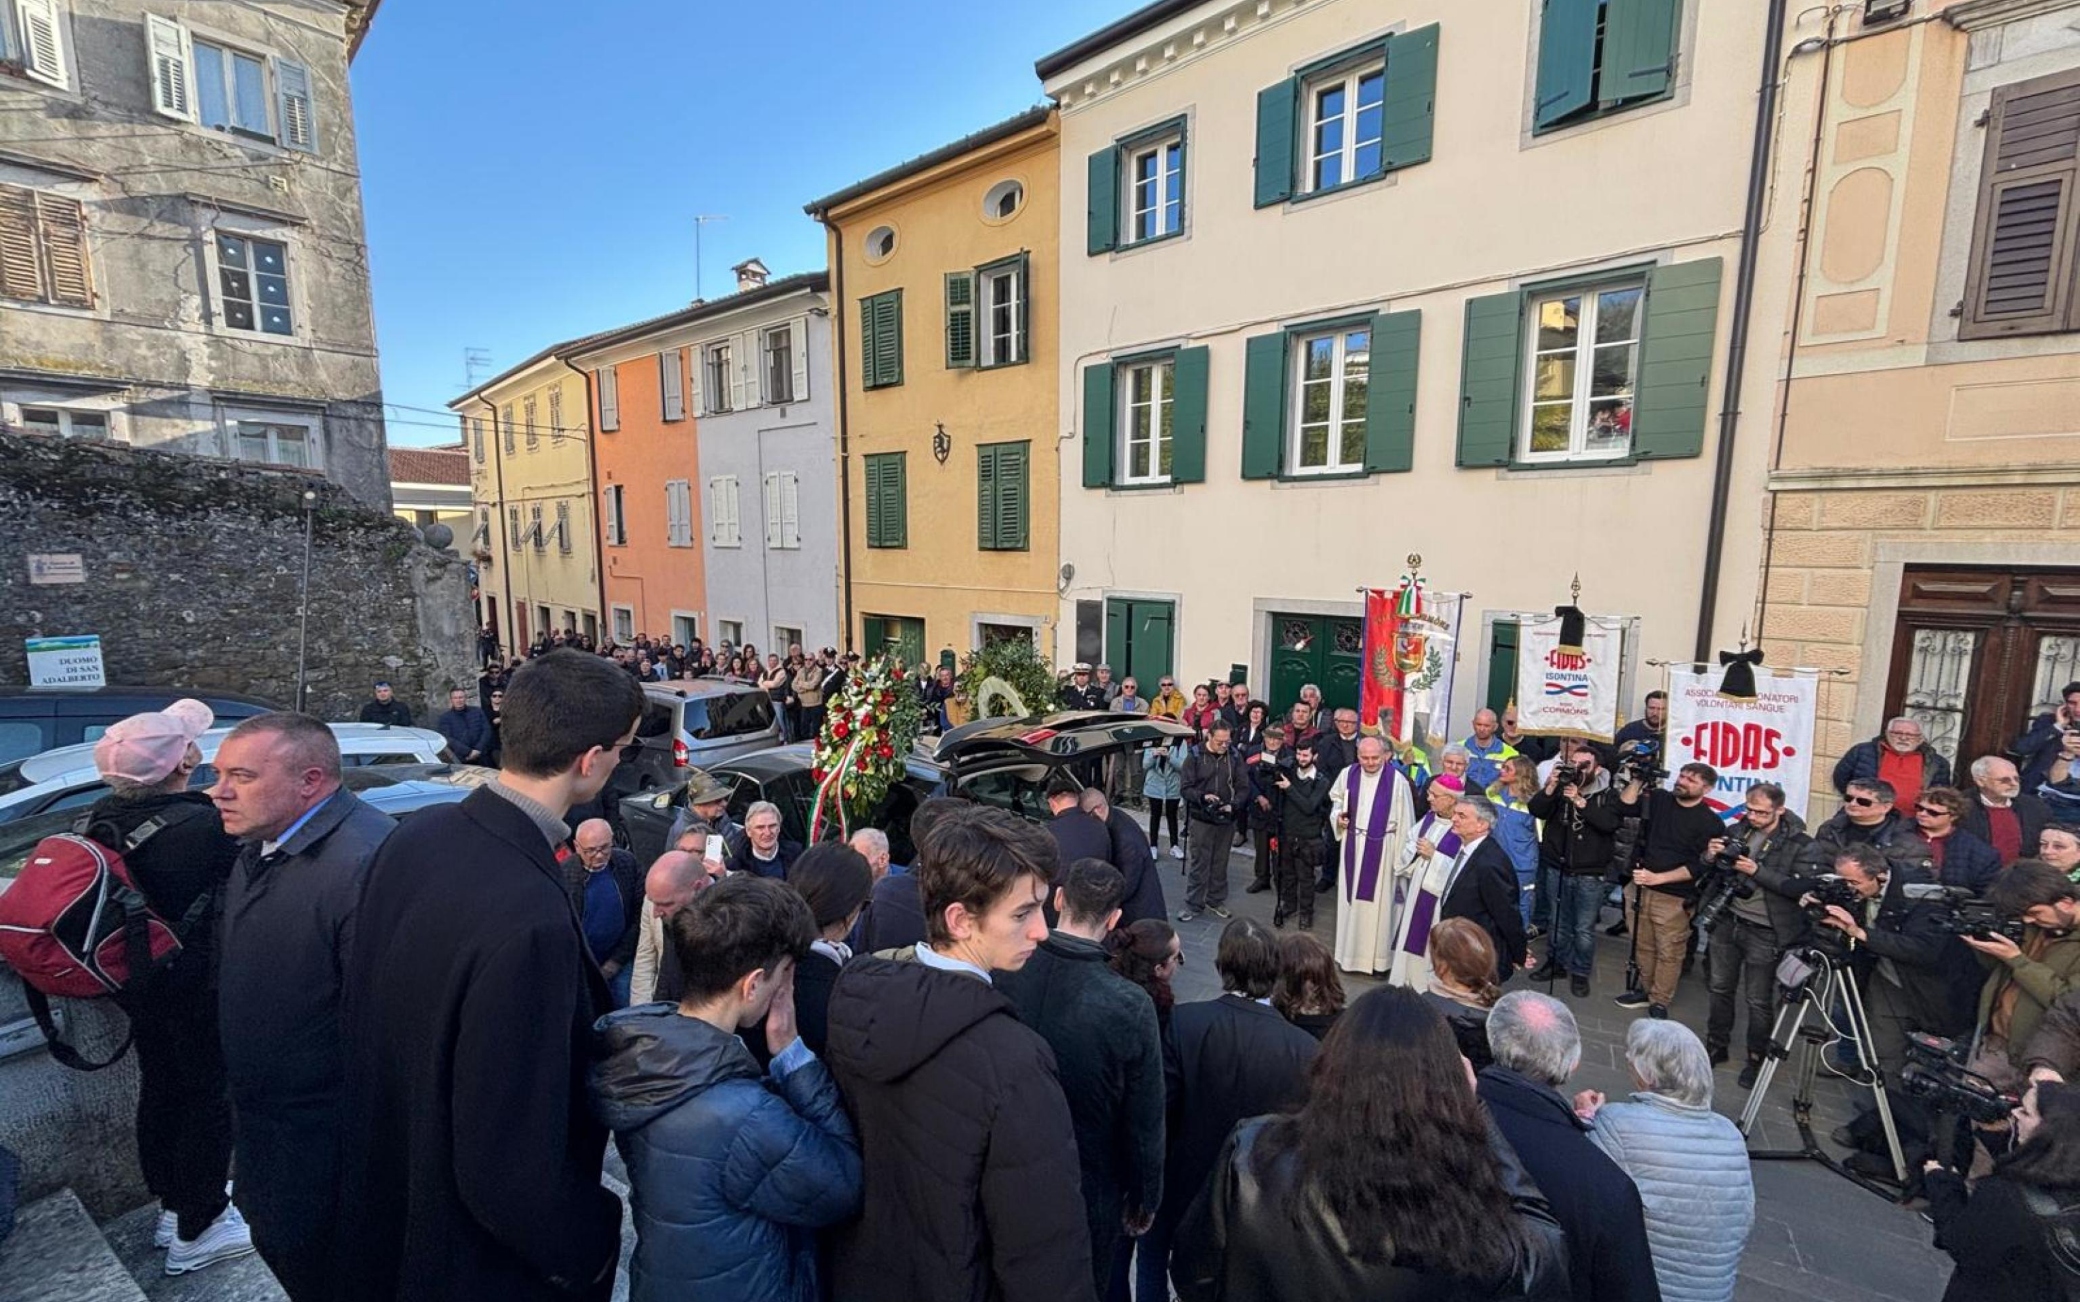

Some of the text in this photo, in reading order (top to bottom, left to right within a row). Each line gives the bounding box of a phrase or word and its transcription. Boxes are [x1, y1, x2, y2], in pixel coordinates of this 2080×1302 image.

[60, 656, 97, 665] DUOMO
[1550, 649, 1586, 671] FIDAS
[43, 674, 100, 684] ADALBERTO
[1545, 672, 1588, 682] ISONTINA
[1757, 692, 1798, 703] ONATORI
[1746, 702, 1785, 713] SANGUE
[1694, 721, 1781, 770] FIDAS
